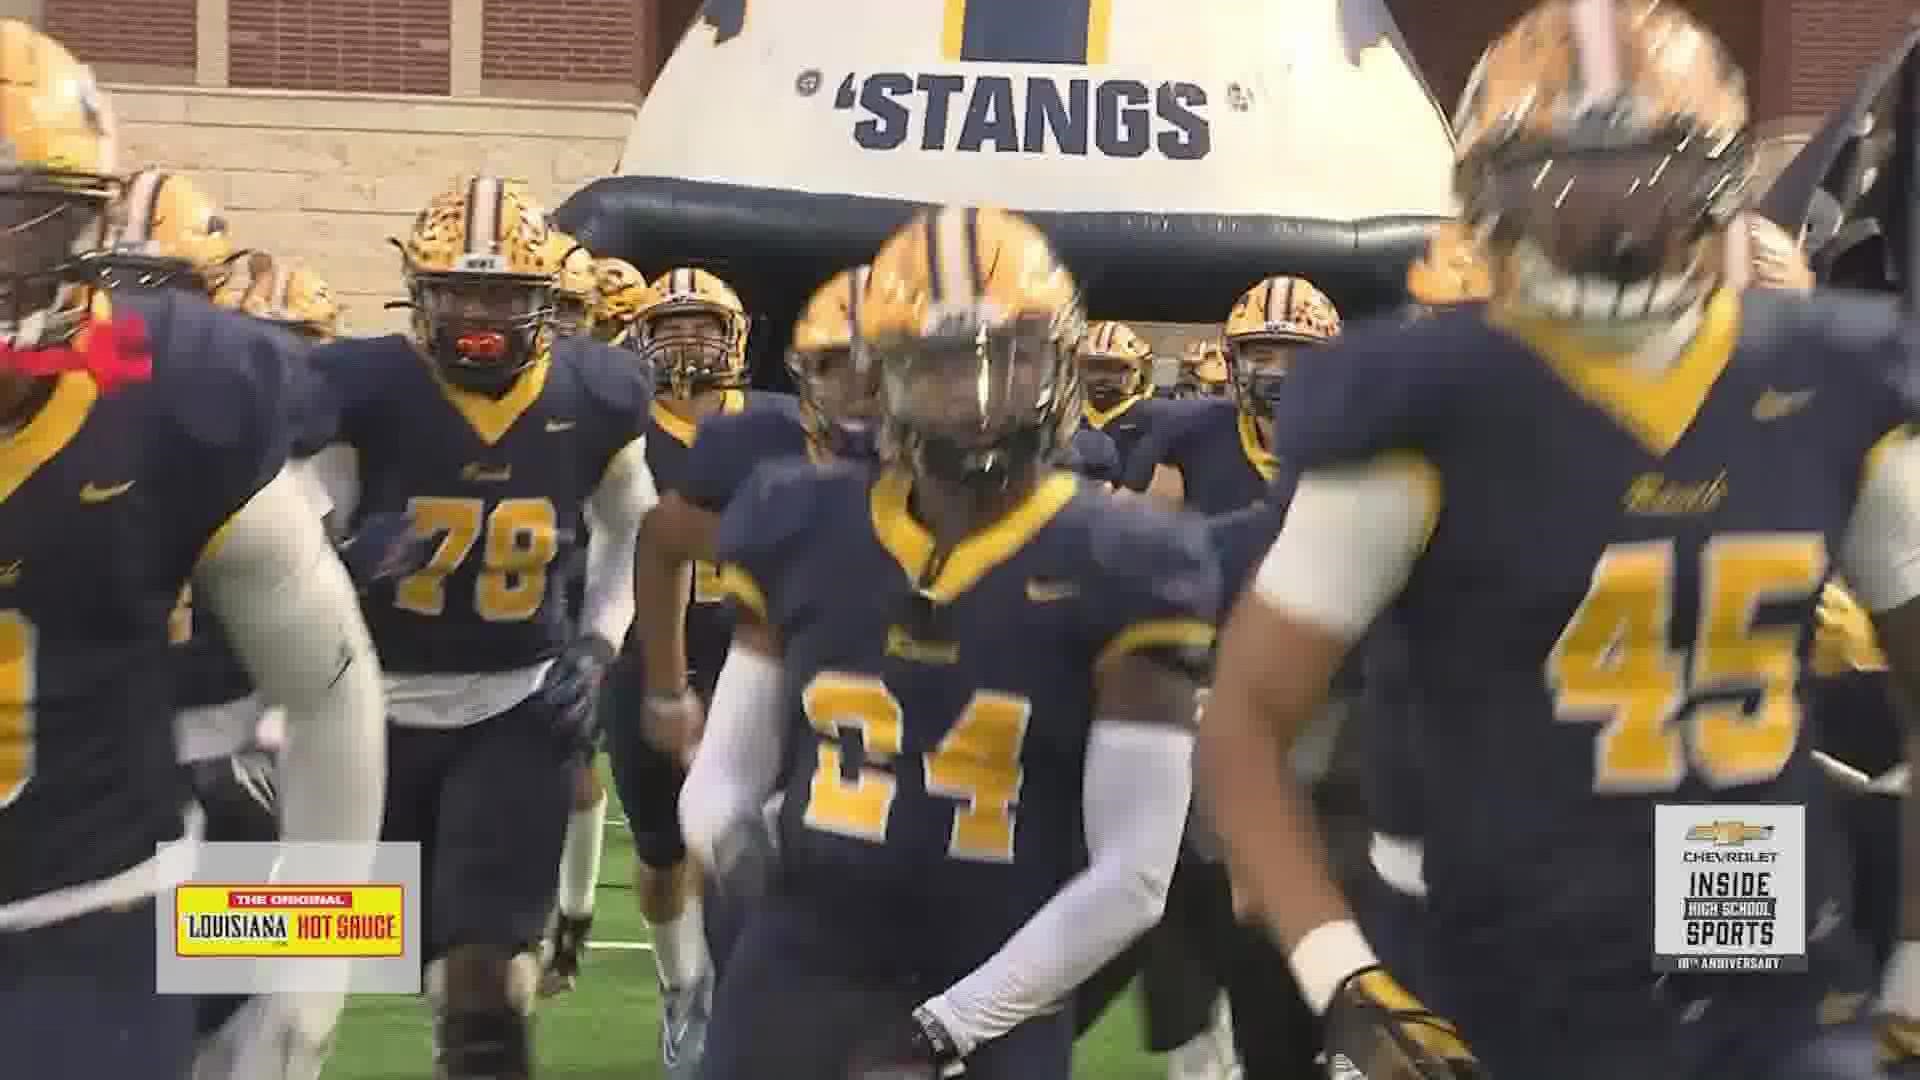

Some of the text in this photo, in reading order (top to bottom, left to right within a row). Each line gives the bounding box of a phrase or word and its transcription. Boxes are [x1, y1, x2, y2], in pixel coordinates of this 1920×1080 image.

[395, 496, 557, 622] 78
[1544, 531, 1830, 794] 45
[801, 670, 1032, 864] 24
